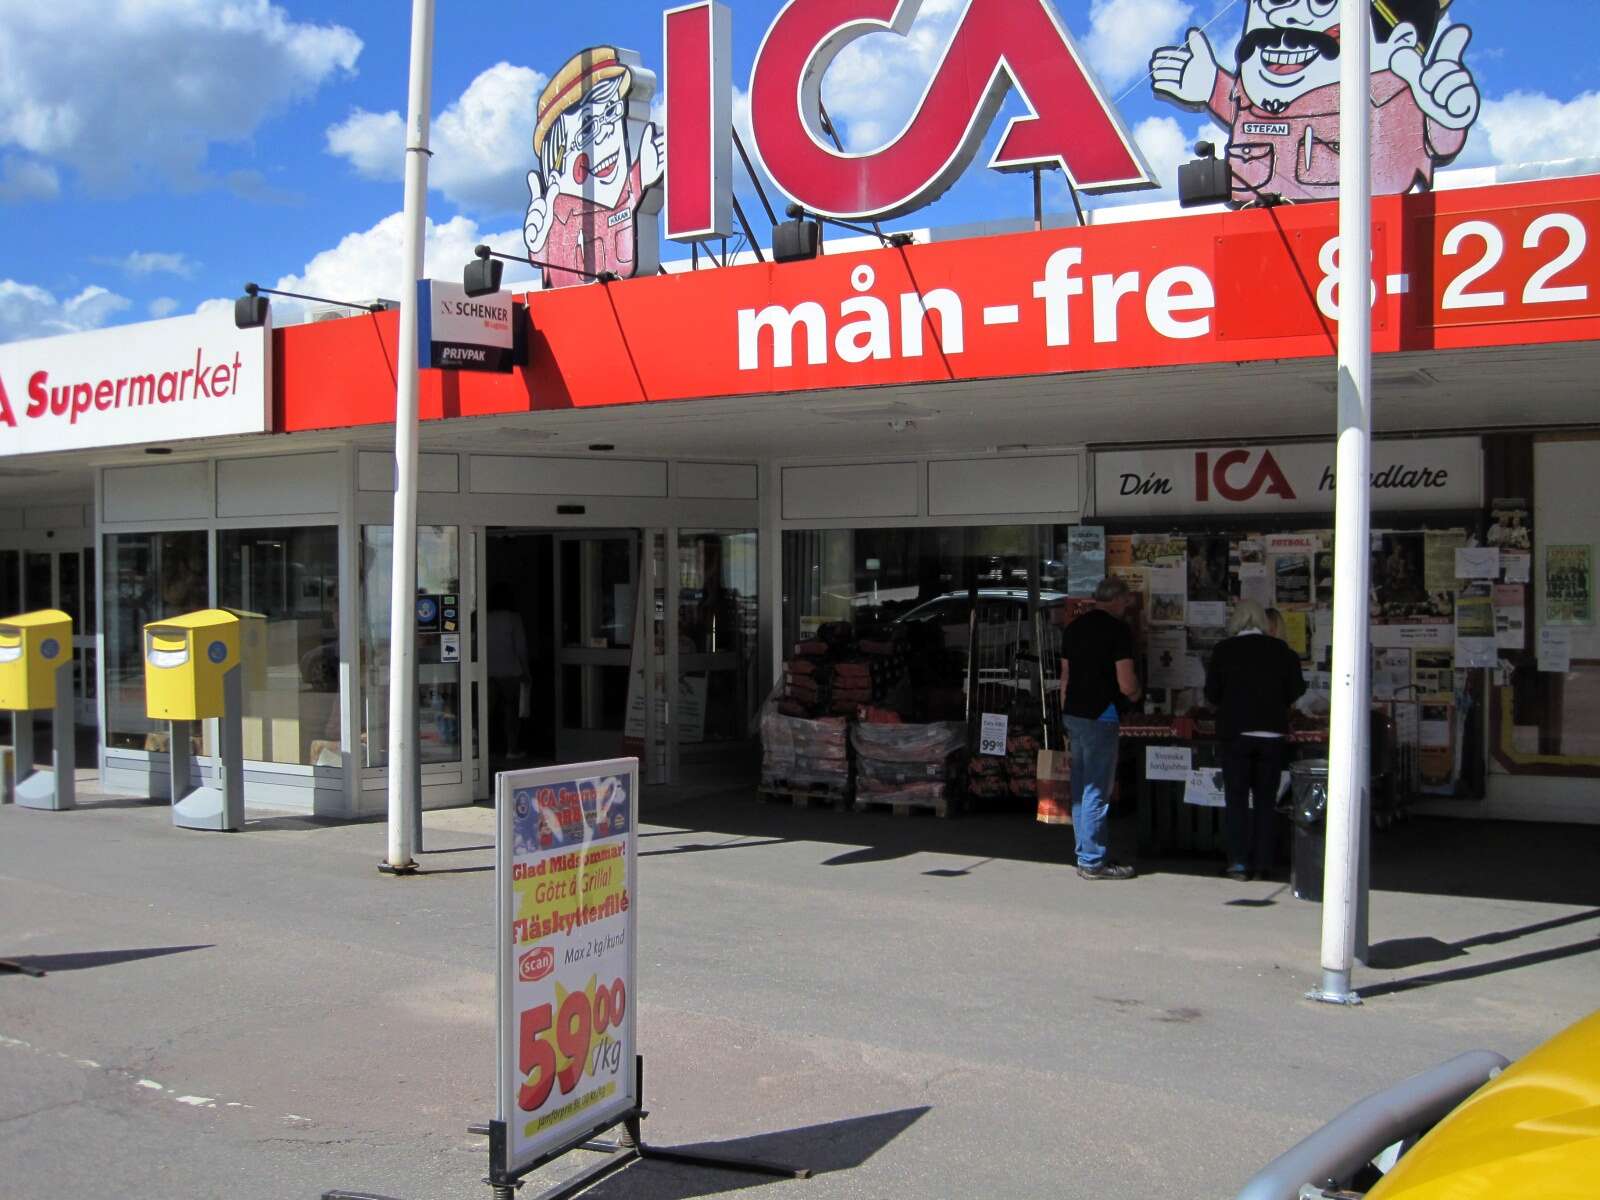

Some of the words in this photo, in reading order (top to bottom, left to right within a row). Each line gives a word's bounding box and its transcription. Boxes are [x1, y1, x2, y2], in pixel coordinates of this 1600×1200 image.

[663, 0, 1150, 240] ICA
[1246, 124, 1286, 134] STEFAN
[455, 302, 509, 321] SCHENKER
[442, 347, 486, 361] PRIVPAK
[26, 347, 242, 425] Supermarket
[1119, 472, 1172, 495] Din
[1195, 449, 1297, 501] ICA
[1318, 464, 1448, 492] hdlare
[512, 859, 546, 881] Glad
[549, 841, 626, 874] Midsommar!
[564, 947, 584, 965] Max
[586, 941, 592, 957] 2
[593, 928, 625, 957] kg/kund
